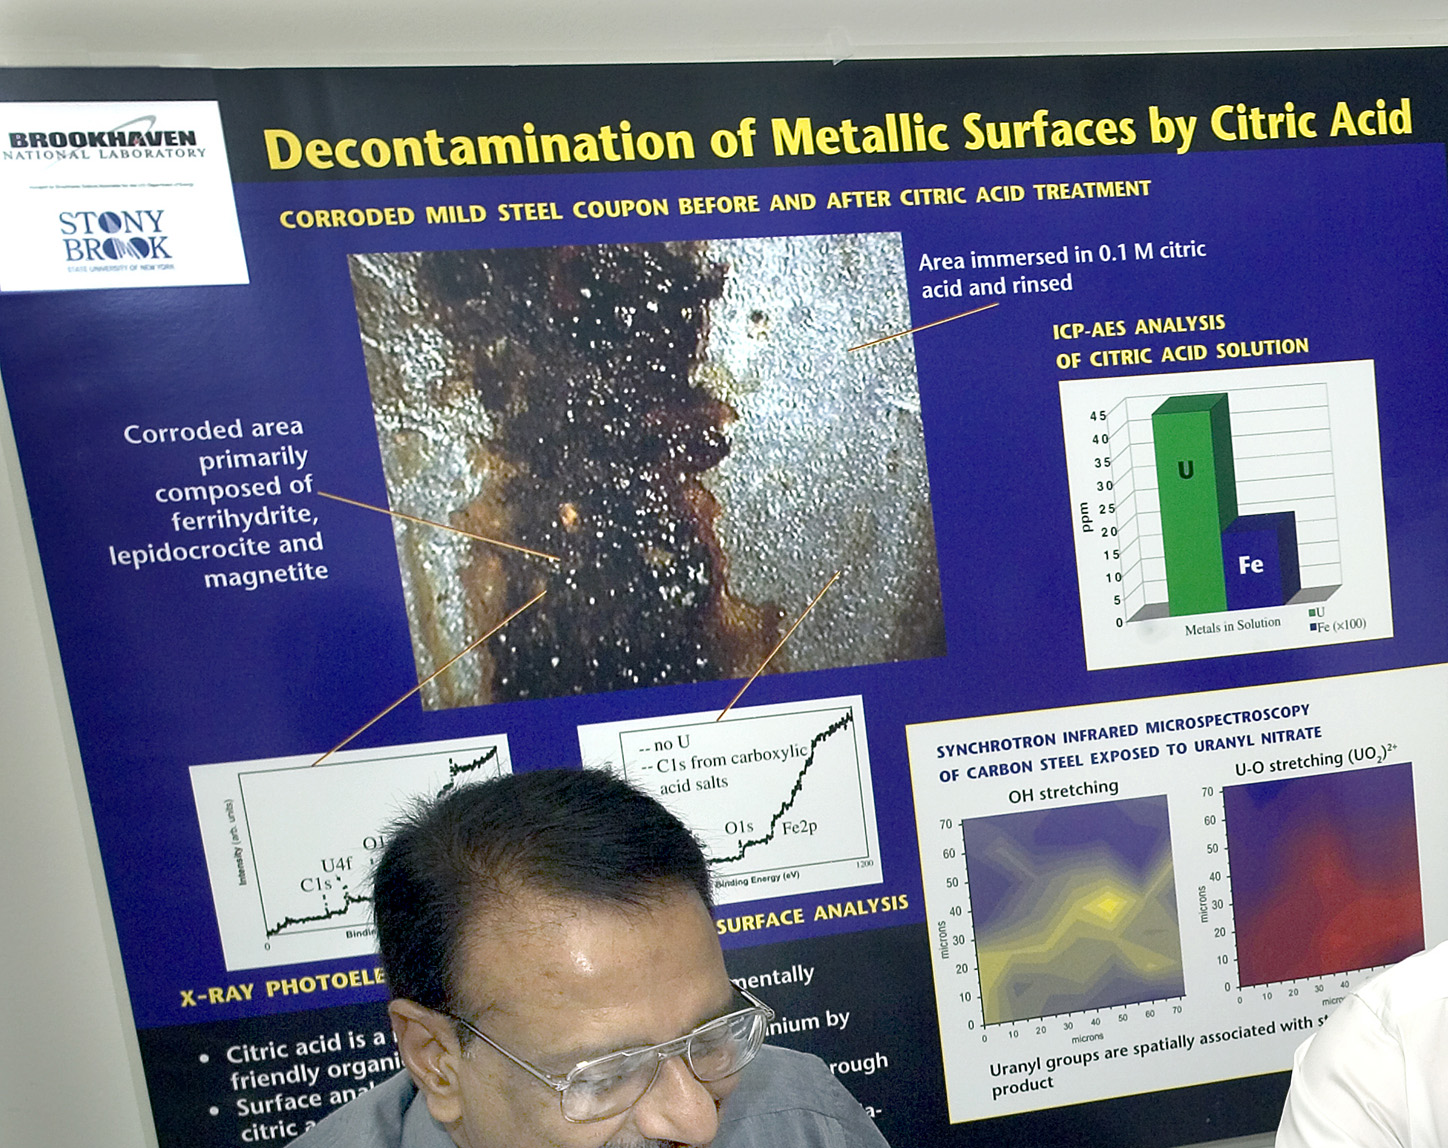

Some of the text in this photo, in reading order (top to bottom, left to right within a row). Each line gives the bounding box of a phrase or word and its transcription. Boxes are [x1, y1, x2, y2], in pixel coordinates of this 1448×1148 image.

[10, 131, 196, 147] BROOKHAVEN
[264, 98, 1412, 169] Decontamination of Metallic Surfaces by Citric Acid
[3, 148, 203, 161] NATIONAL LABORATORY
[280, 180, 1151, 228] CORRODED MILD STEEL COUPON BEFORE AND AFTER CITRIC ACID TREATMENT
[59, 210, 163, 234] STONY
[64, 236, 172, 261] BROOK
[919, 240, 1206, 271] Area immersed in 0.1 M citric
[922, 273, 1072, 298] acid and rinsed
[1053, 314, 1225, 340] ICP-AES ANALYSIS
[1056, 338, 1308, 369] OF CITRIC ACID SOLUTION
[124, 419, 303, 443] Corroded area
[200, 445, 307, 476] primarily
[1178, 461, 1193, 479] U
[156, 474, 312, 505] composed of
[172, 505, 318, 532] ferrihydrite,
[1080, 502, 1094, 532] ppm
[110, 532, 323, 569] lepidocrocite and
[205, 562, 328, 590] magnetite
[1239, 556, 1263, 574] Fe
[1317, 607, 1324, 617] U
[1186, 623, 1221, 635] Metals
[1238, 619, 1281, 630] Solution
[1318, 622, 1329, 632] Fe
[655, 735, 689, 751] no U
[937, 704, 1309, 758] SYNCHROTRON INFRARED MICROSPECTROSCOPY
[691, 756, 726, 769] from
[732, 745, 807, 764] carboxylic
[940, 726, 1321, 782] OF CARBON STEEL EXPOSED TO URANYL NITRATE
[1236, 753, 1342, 776] U-O stretching
[661, 776, 728, 795] acid salts
[1009, 781, 1118, 803] OH stretching
[783, 820, 817, 835] Fe2p
[322, 857, 350, 872] U4f
[181, 895, 908, 1007] X-RAY PHOTOELE SURFACE ANALYSIS
[227, 1031, 365, 1063] Citric acid is
[990, 1017, 1312, 1076] Uranyl groups are spatially associated with
[231, 1064, 319, 1090] friendly
[993, 1077, 1053, 1100] product
[237, 1093, 321, 1116] Surface
[242, 1120, 297, 1142] citric
